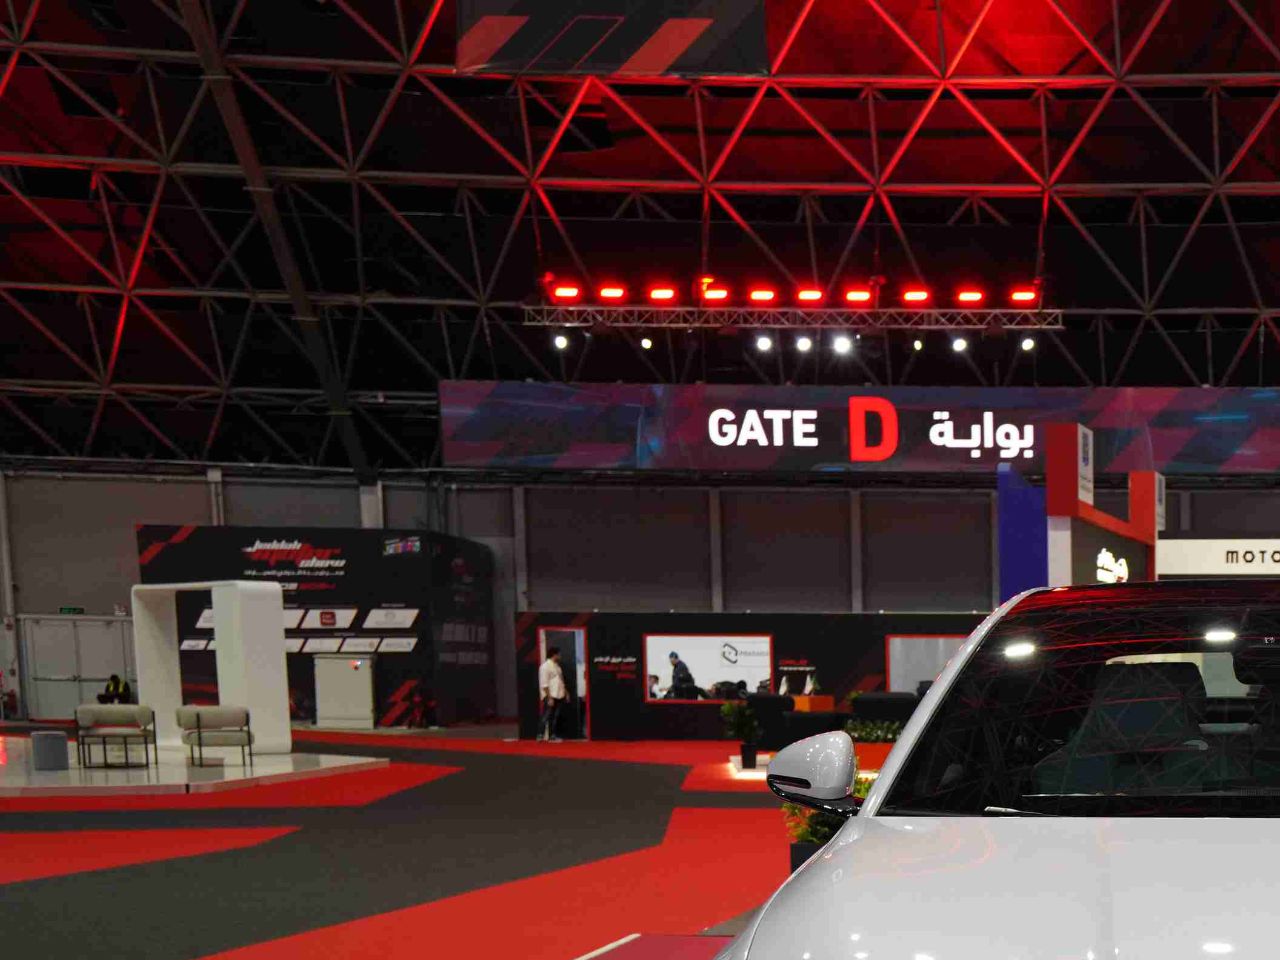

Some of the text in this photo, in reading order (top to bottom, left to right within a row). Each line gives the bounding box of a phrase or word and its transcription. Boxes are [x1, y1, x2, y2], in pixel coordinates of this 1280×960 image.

[708, 396, 898, 462] GATE D
[928, 410, 1035, 459] بوابة
